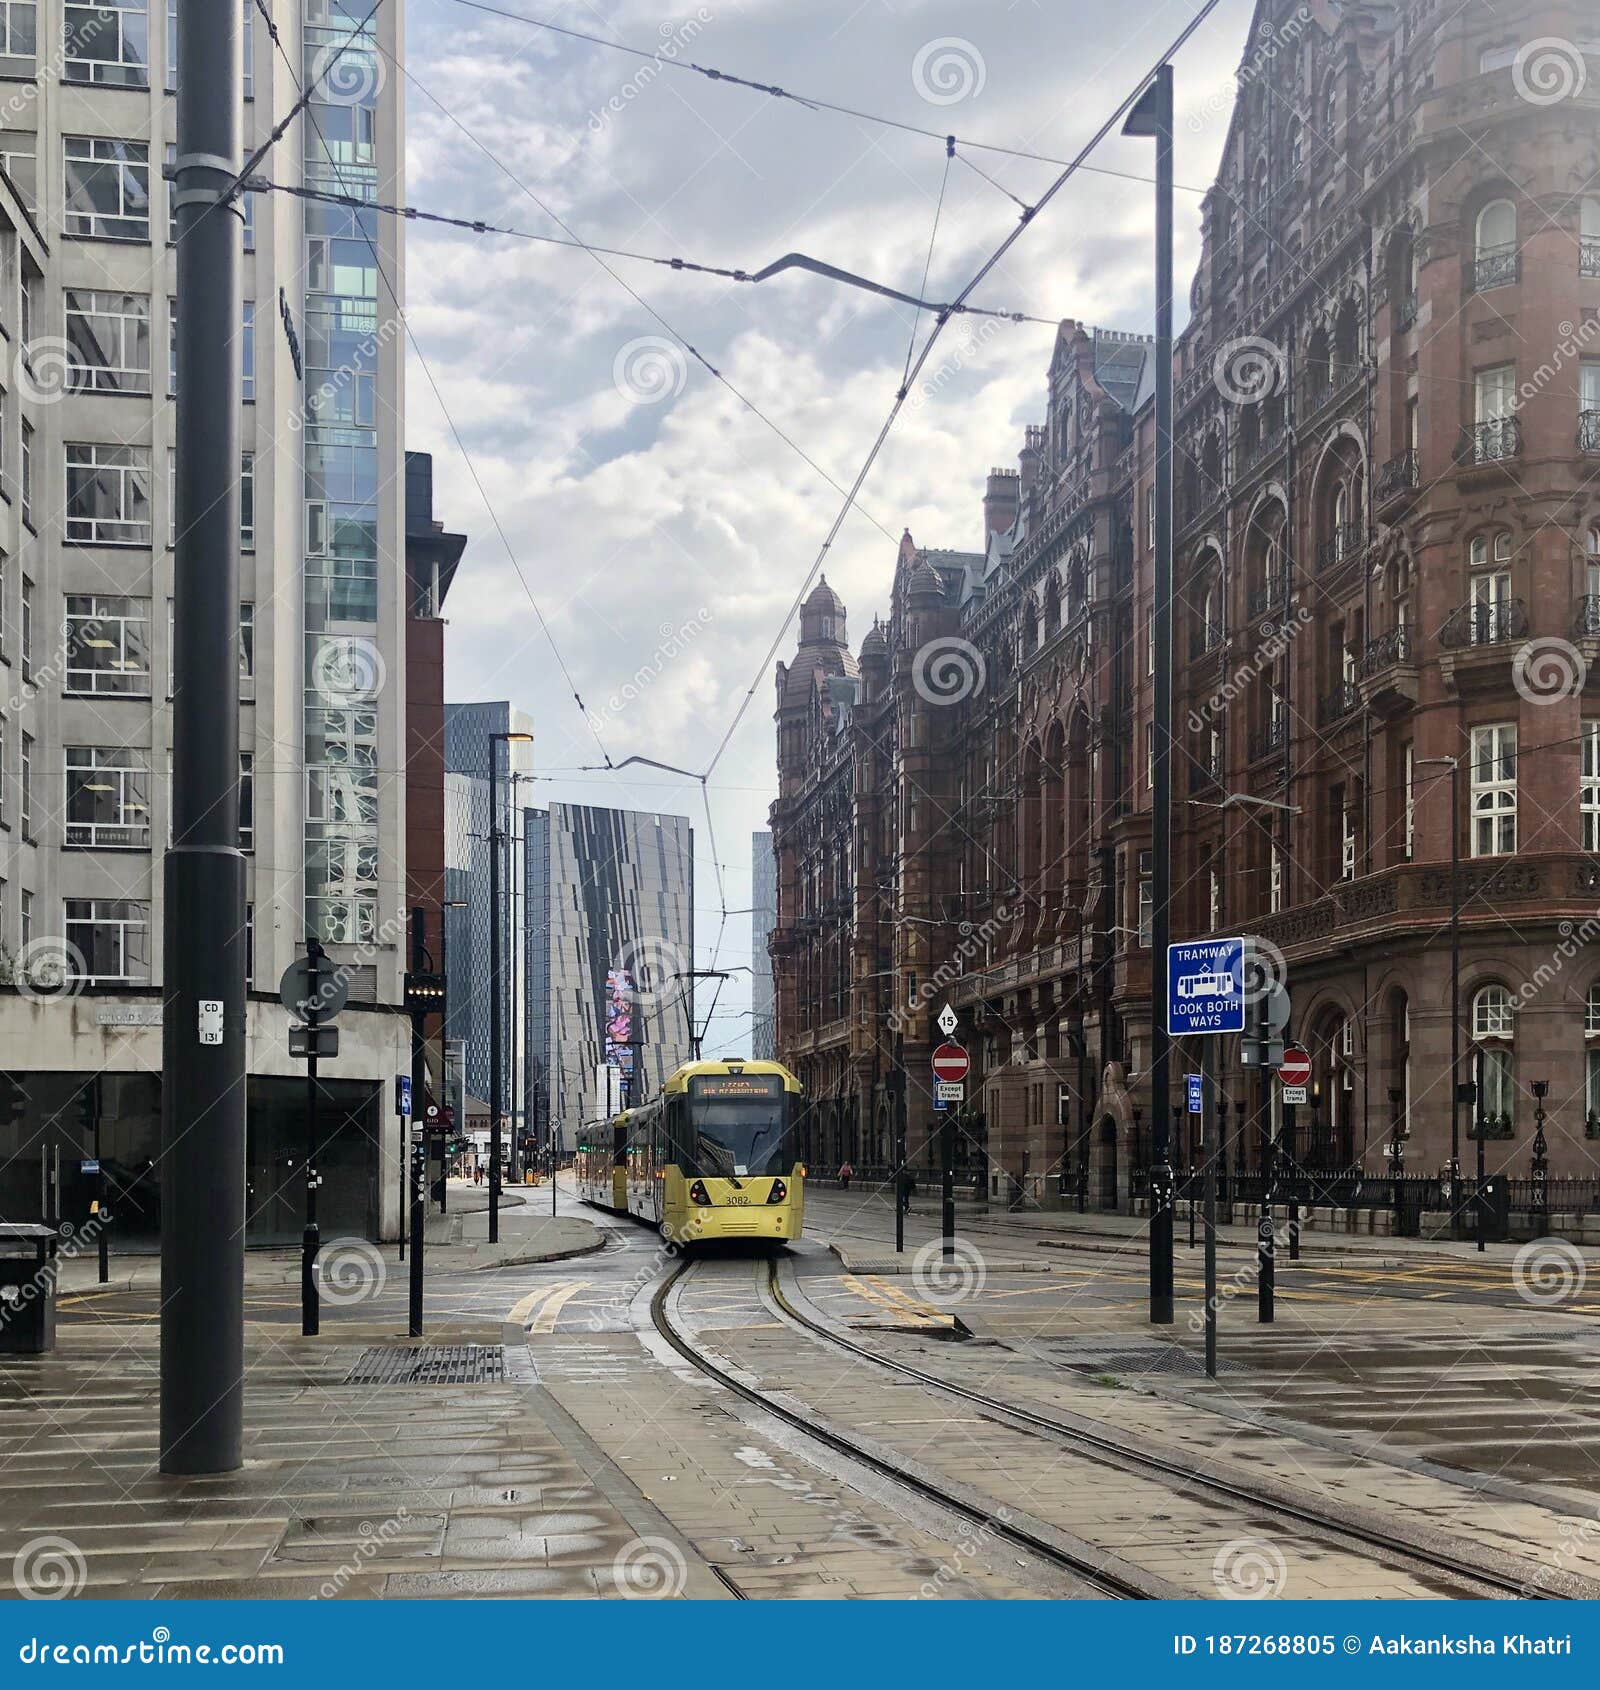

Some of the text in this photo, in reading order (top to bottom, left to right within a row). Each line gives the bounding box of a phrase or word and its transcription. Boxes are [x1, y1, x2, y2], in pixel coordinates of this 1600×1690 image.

[1177, 945, 1233, 961] TRAMWAY
[204, 1003, 218, 1013] CD
[1173, 1000, 1239, 1015] LOOK BOTH
[942, 1016, 954, 1027] 15
[1189, 1015, 1221, 1027] WAYS
[205, 1033, 218, 1042] 131
